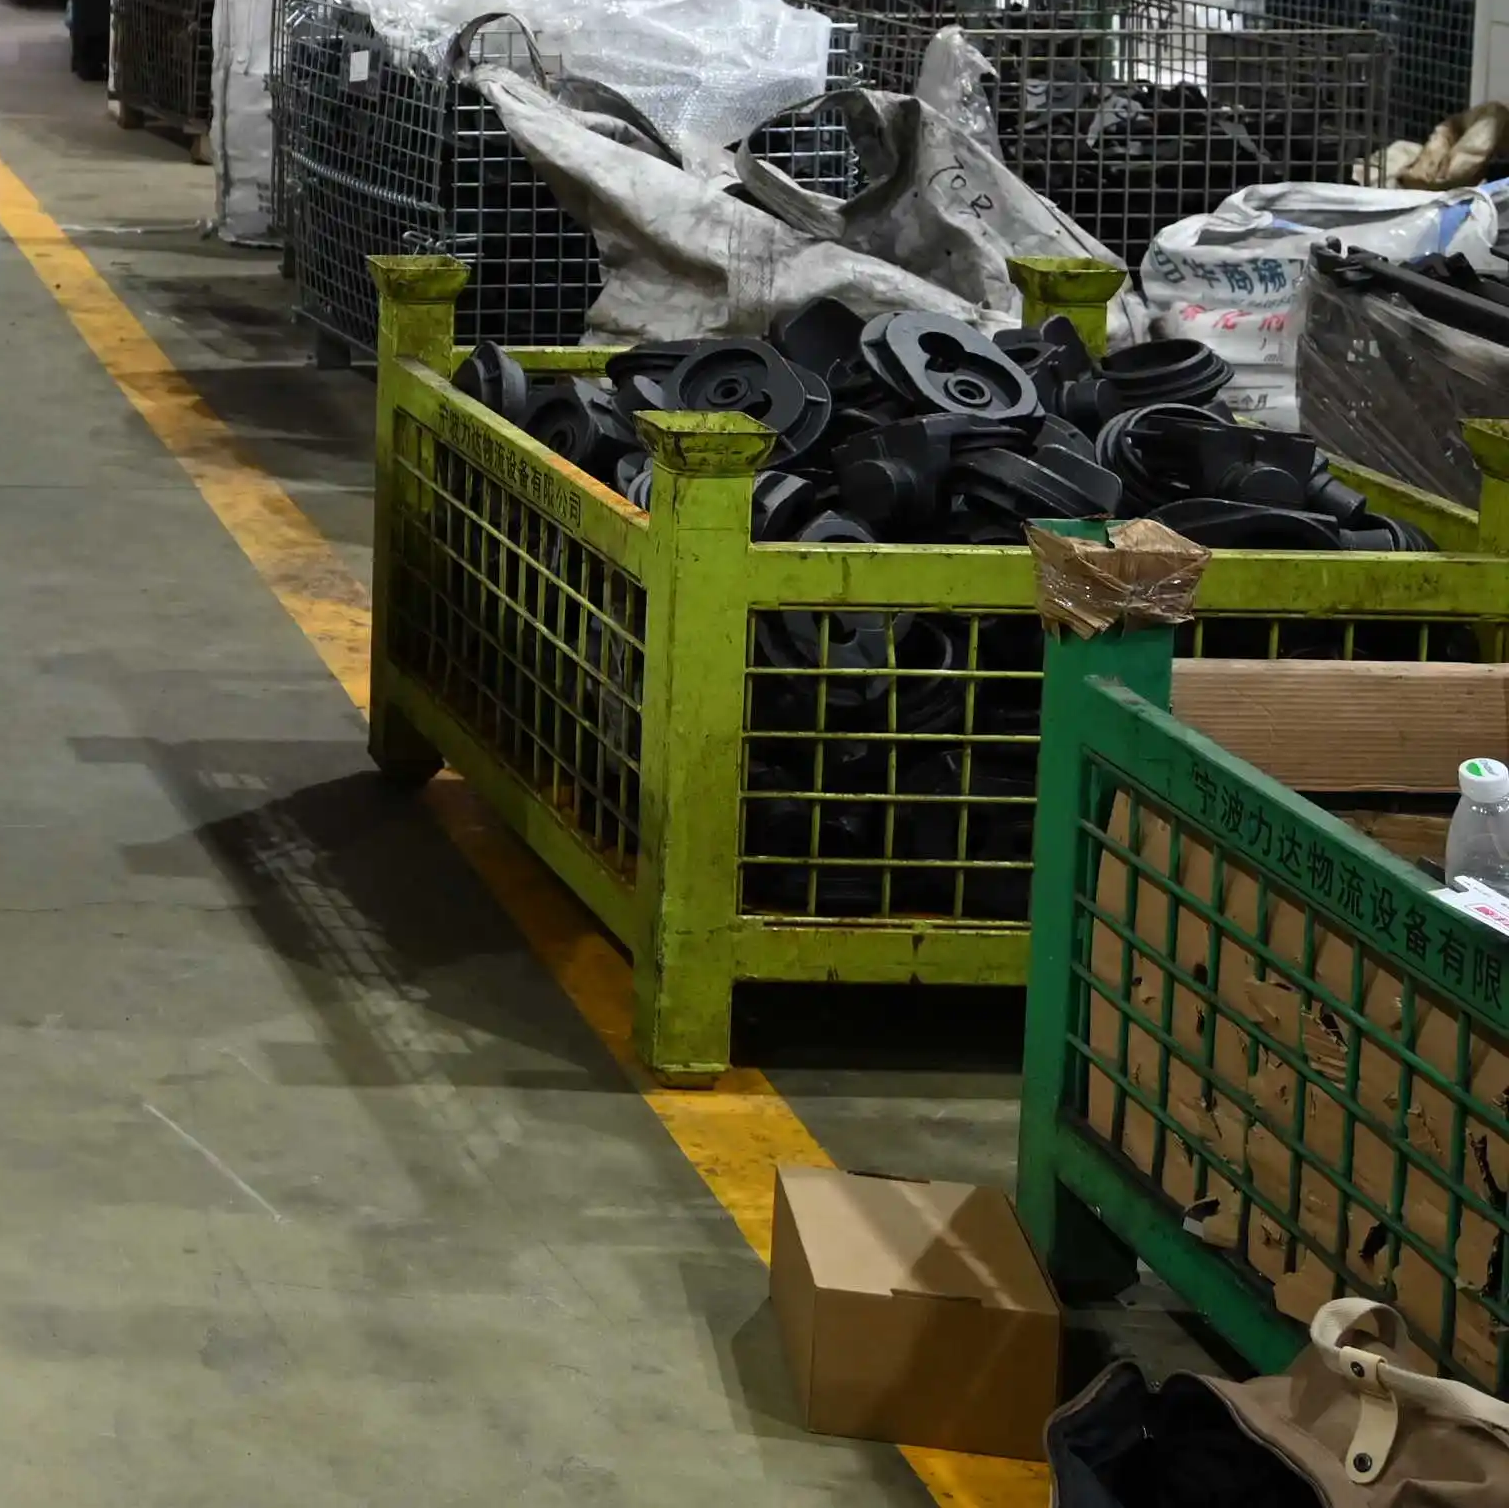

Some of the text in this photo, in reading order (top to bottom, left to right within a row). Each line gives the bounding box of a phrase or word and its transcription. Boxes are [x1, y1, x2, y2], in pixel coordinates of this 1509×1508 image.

[1190, 762, 1503, 1009] 宁波力达物流设备有限
